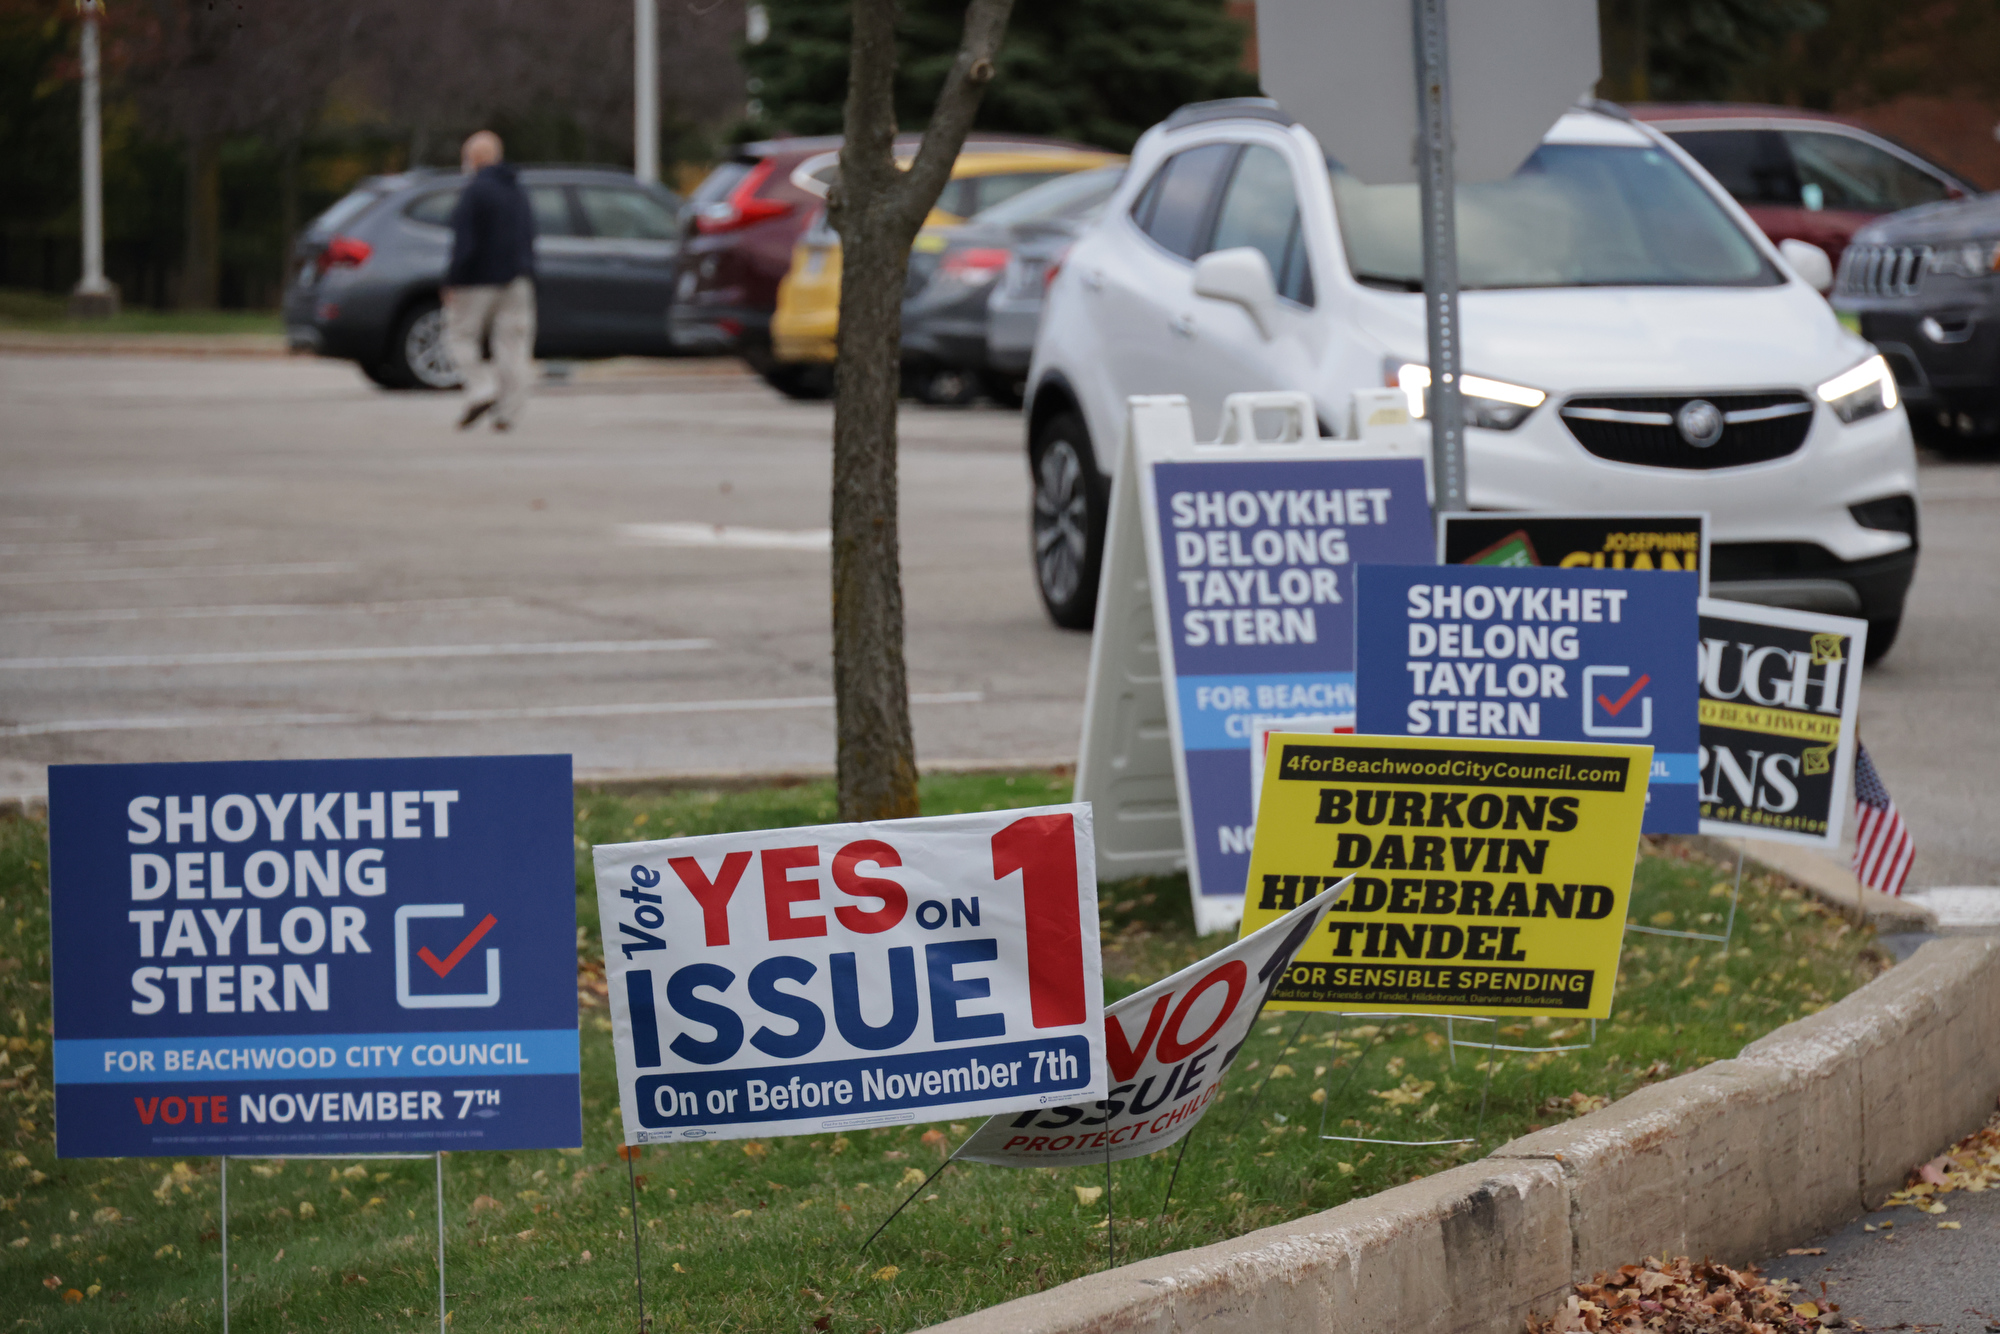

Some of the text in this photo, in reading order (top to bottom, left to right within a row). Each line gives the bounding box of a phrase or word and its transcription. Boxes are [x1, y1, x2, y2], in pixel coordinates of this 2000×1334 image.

[1171, 488, 1391, 528] SHOYKHET
[1175, 529, 1349, 567] DELONG
[1603, 532, 1698, 551] JOSEPHINE
[1178, 568, 1342, 606] TAYLOR
[1407, 584, 1627, 624] SHOYKHET
[1182, 607, 1316, 646] STERN
[1408, 624, 1579, 660] DELONG
[1196, 685, 1251, 711] FOR
[1406, 662, 1568, 699] TAYLOR
[1407, 701, 1541, 737] STERN
[1287, 754, 1621, 783] 4forBeachwoodCityCouncil.com
[127, 790, 458, 843] SHOYKHET
[1315, 788, 1580, 832] BURKONS
[1332, 833, 1550, 874] DARVIN
[130, 849, 386, 900] DELONG
[619, 864, 667, 961] Vote
[1258, 873, 1615, 920] HILDEBRAND
[128, 906, 371, 957] TAYLOR
[667, 813, 1086, 1029] YES ON 1
[1328, 921, 1526, 962] TINDEL
[131, 964, 328, 1014] STERN
[1279, 967, 1585, 993] FOR SENSIBLE SPENDING
[1296, 989, 1311, 998] for
[1312, 990, 1325, 1000] by
[1327, 990, 1363, 1000] Friends
[625, 938, 1006, 1068] ISSUE
[1105, 960, 1247, 1083] NO
[104, 1043, 528, 1073] FOR BEACHWOOD CITY COUNCIL
[654, 1049, 1078, 1118] On or Before November 7th
[134, 1096, 228, 1125] VOTE
[240, 1090, 444, 1124] NOVEMBER
[1002, 1120, 1150, 1151] PROTECT
